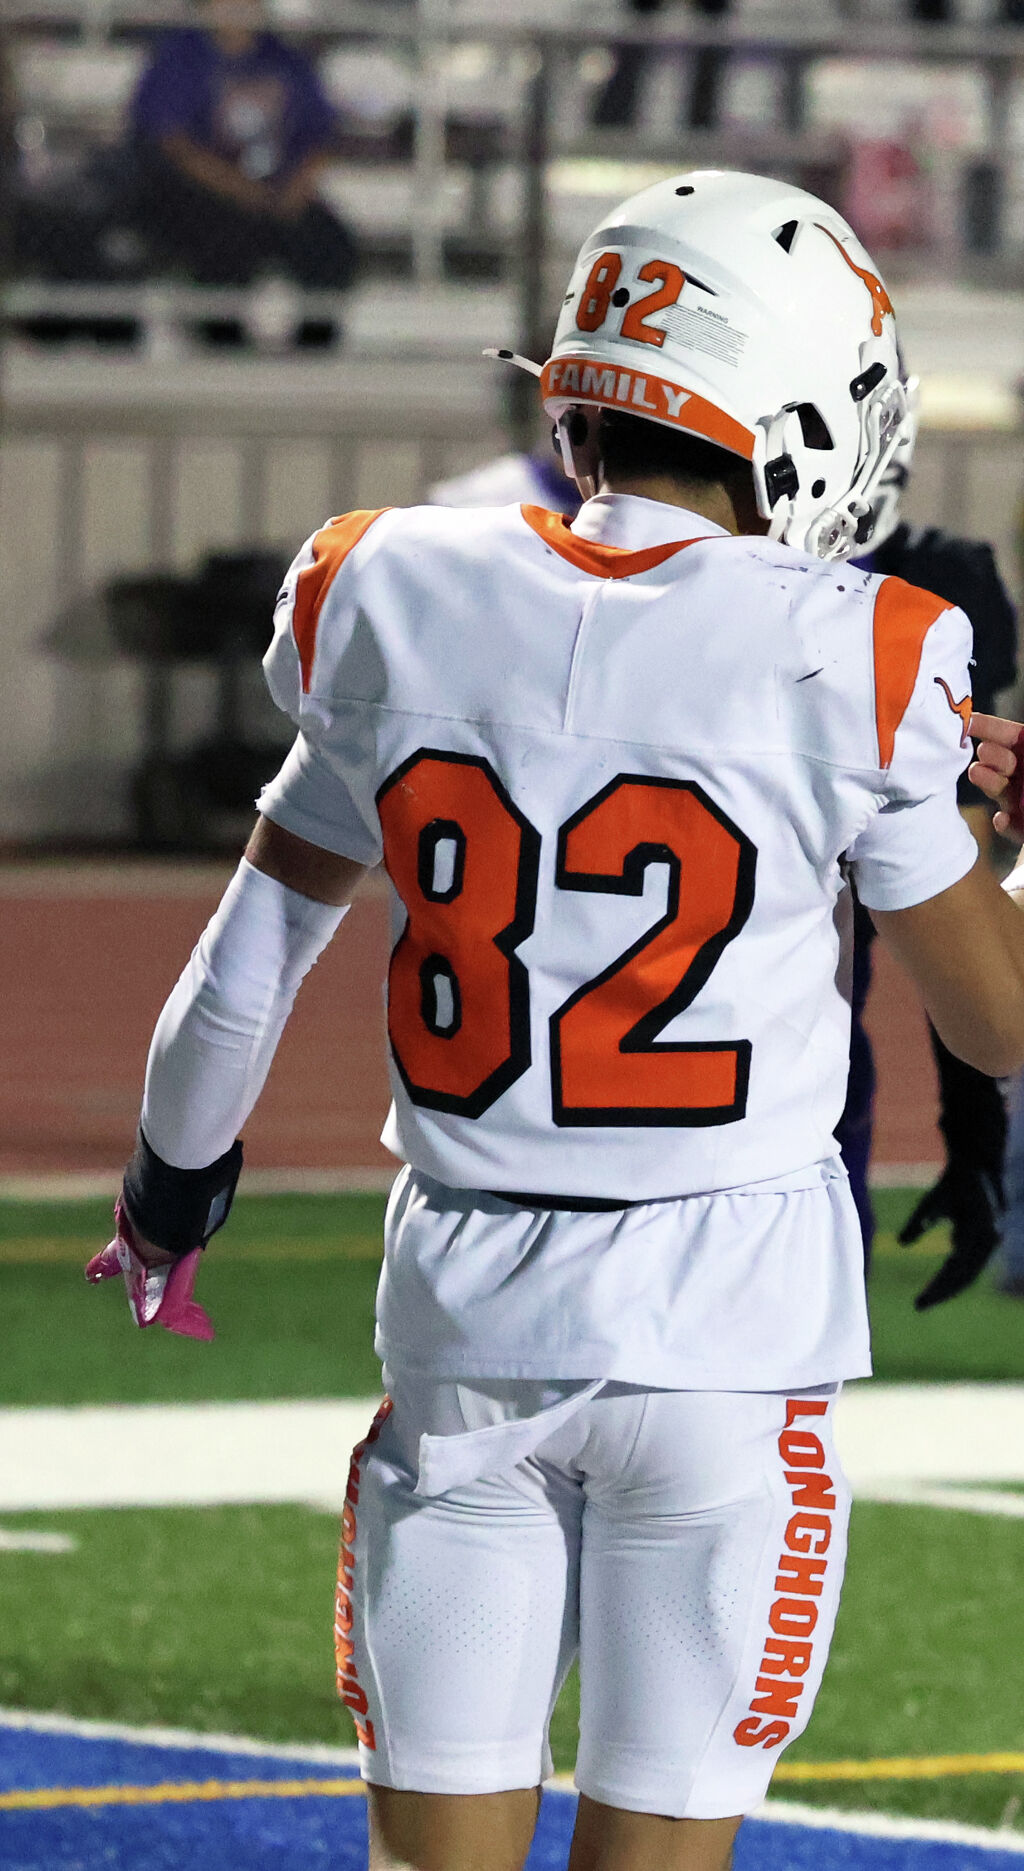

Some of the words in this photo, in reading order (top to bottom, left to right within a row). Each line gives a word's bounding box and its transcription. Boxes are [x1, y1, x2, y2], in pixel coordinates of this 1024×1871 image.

[549, 363, 692, 418] FAMILY
[575, 252, 687, 348] 82
[375, 747, 758, 1128] 82
[733, 1399, 830, 1749] LONGHORNS
